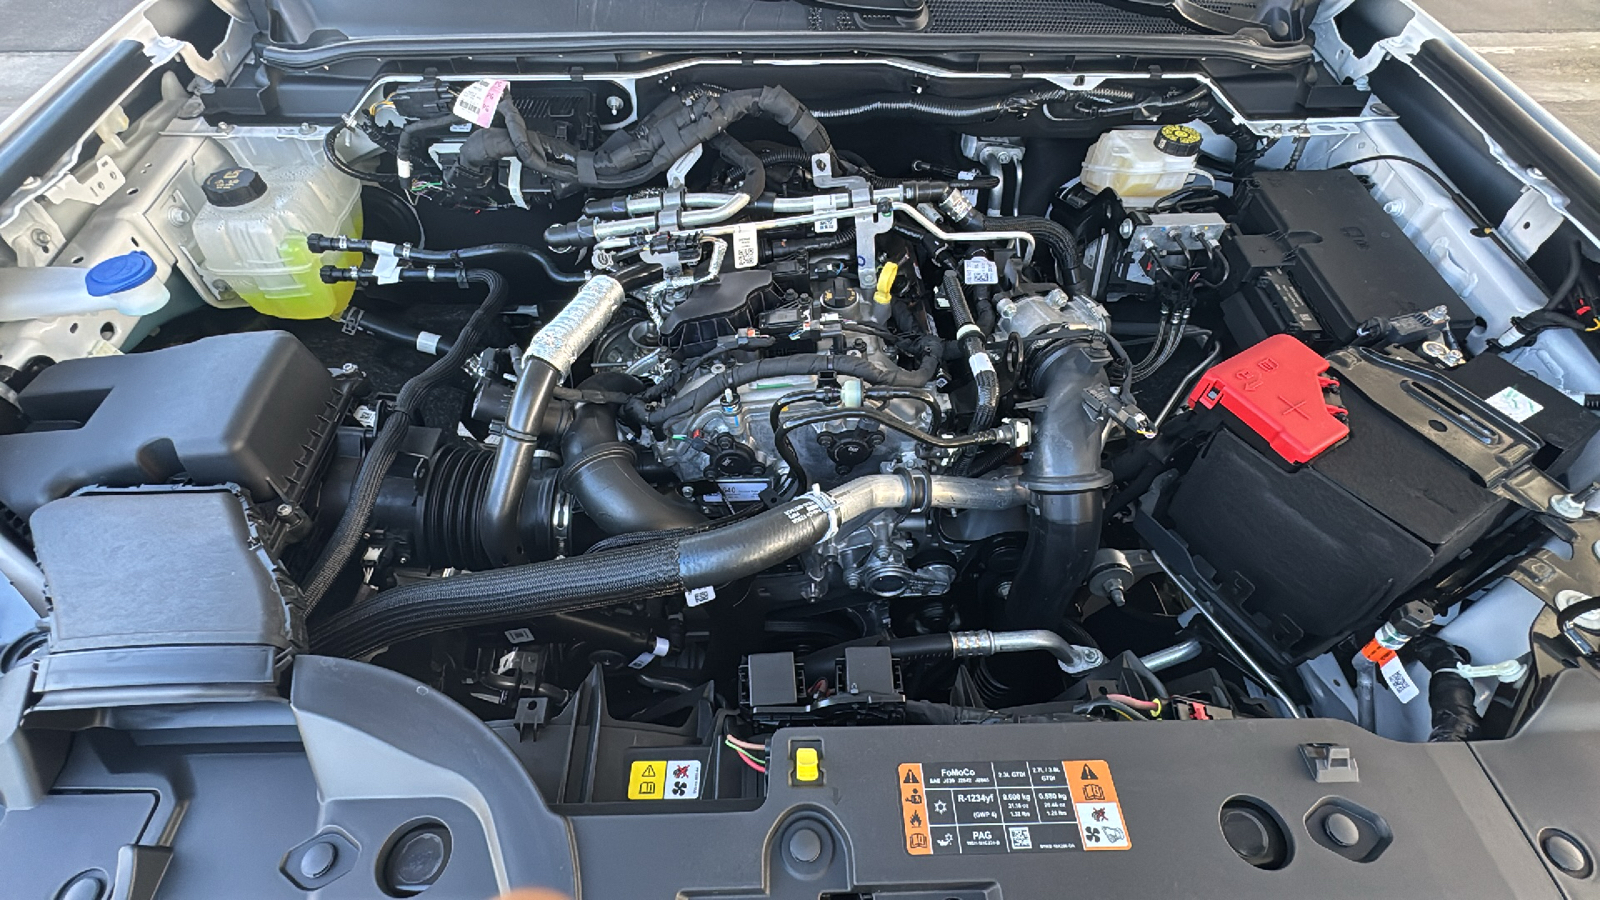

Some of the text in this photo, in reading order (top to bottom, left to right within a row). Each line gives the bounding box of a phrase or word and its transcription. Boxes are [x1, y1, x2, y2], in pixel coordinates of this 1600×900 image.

[941, 768, 976, 777] FoMoCo
[958, 794, 994, 804] R-1234yf
[972, 831, 992, 840] PAG
